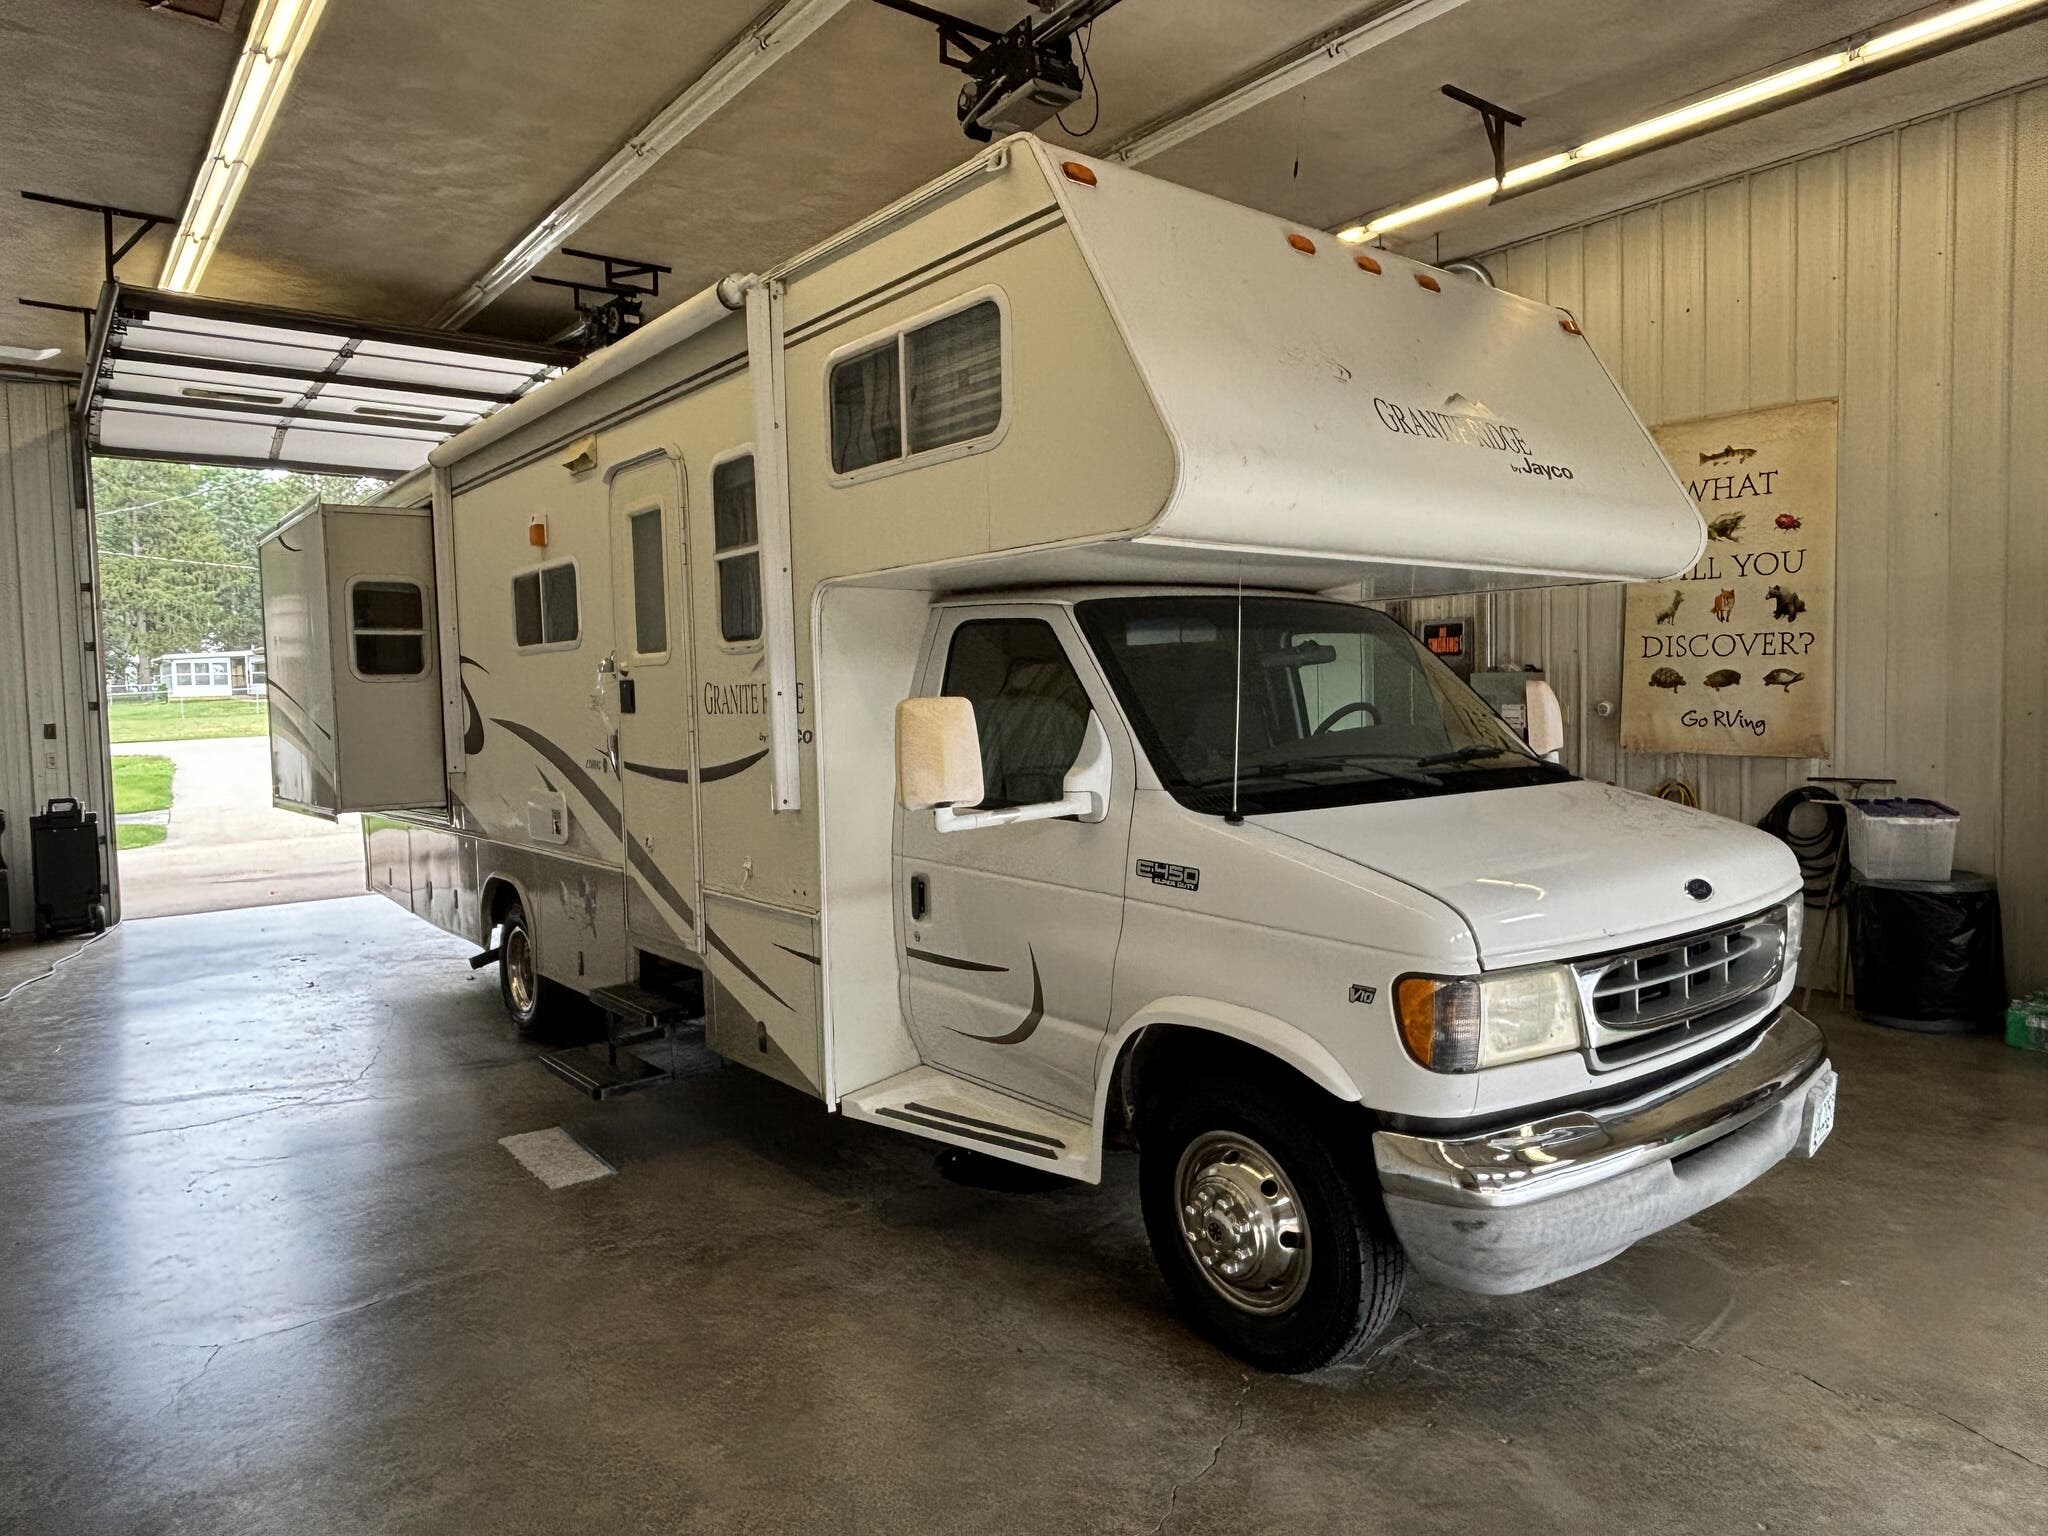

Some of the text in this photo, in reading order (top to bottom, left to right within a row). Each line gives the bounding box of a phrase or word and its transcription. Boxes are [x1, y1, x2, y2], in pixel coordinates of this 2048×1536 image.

[1374, 398, 1533, 456] GRANITE RIDGE
[1522, 457, 1574, 480] Jayco
[1682, 469, 1779, 502] WHAT
[1731, 549, 1807, 577] YOU
[1641, 631, 1815, 659] DISCOVER?
[704, 682, 759, 715] GRANITE
[1681, 710, 1766, 737] Go RVing
[1137, 860, 1199, 885] E450
